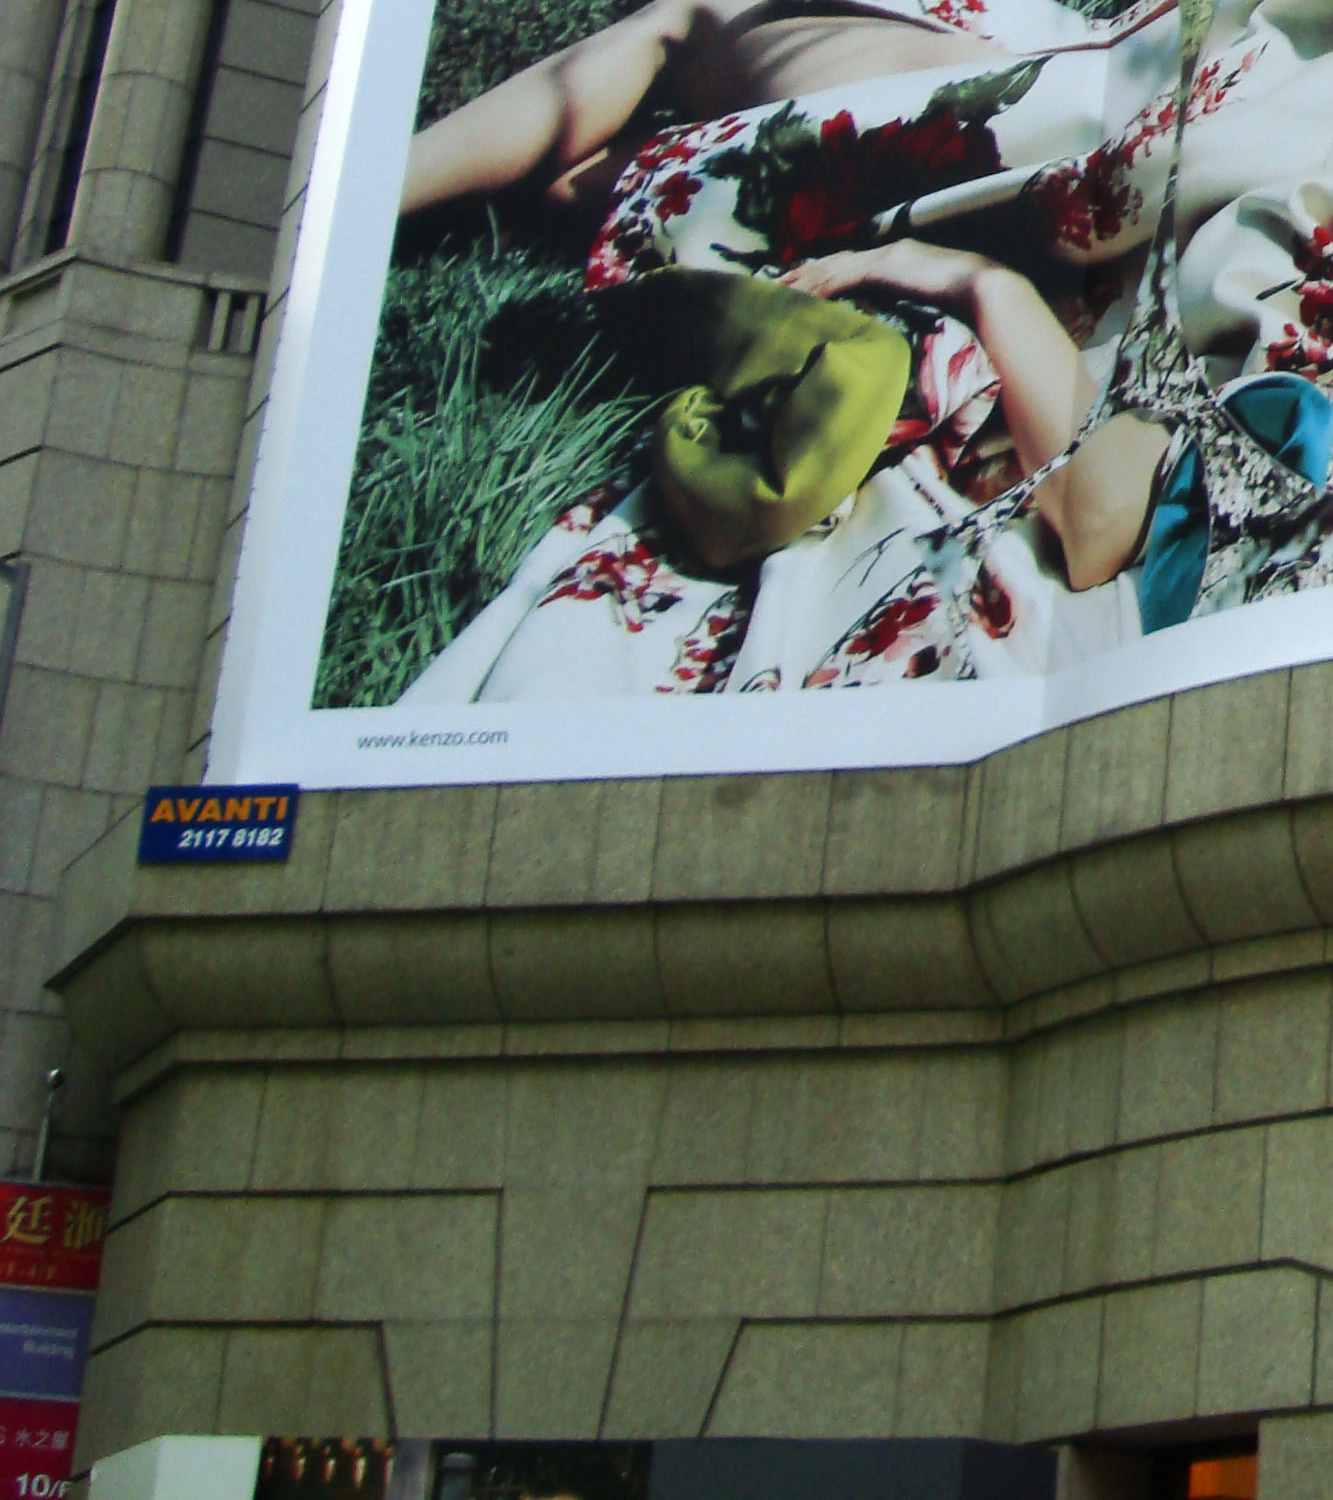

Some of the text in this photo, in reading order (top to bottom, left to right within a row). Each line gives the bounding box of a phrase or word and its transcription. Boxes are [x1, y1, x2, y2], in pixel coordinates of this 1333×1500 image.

[357, 728, 508, 749] www.kenzo.com
[150, 796, 289, 822] AVANTI
[177, 827, 286, 848] 2117 8182
[16, 1472, 73, 1498] 10/F
